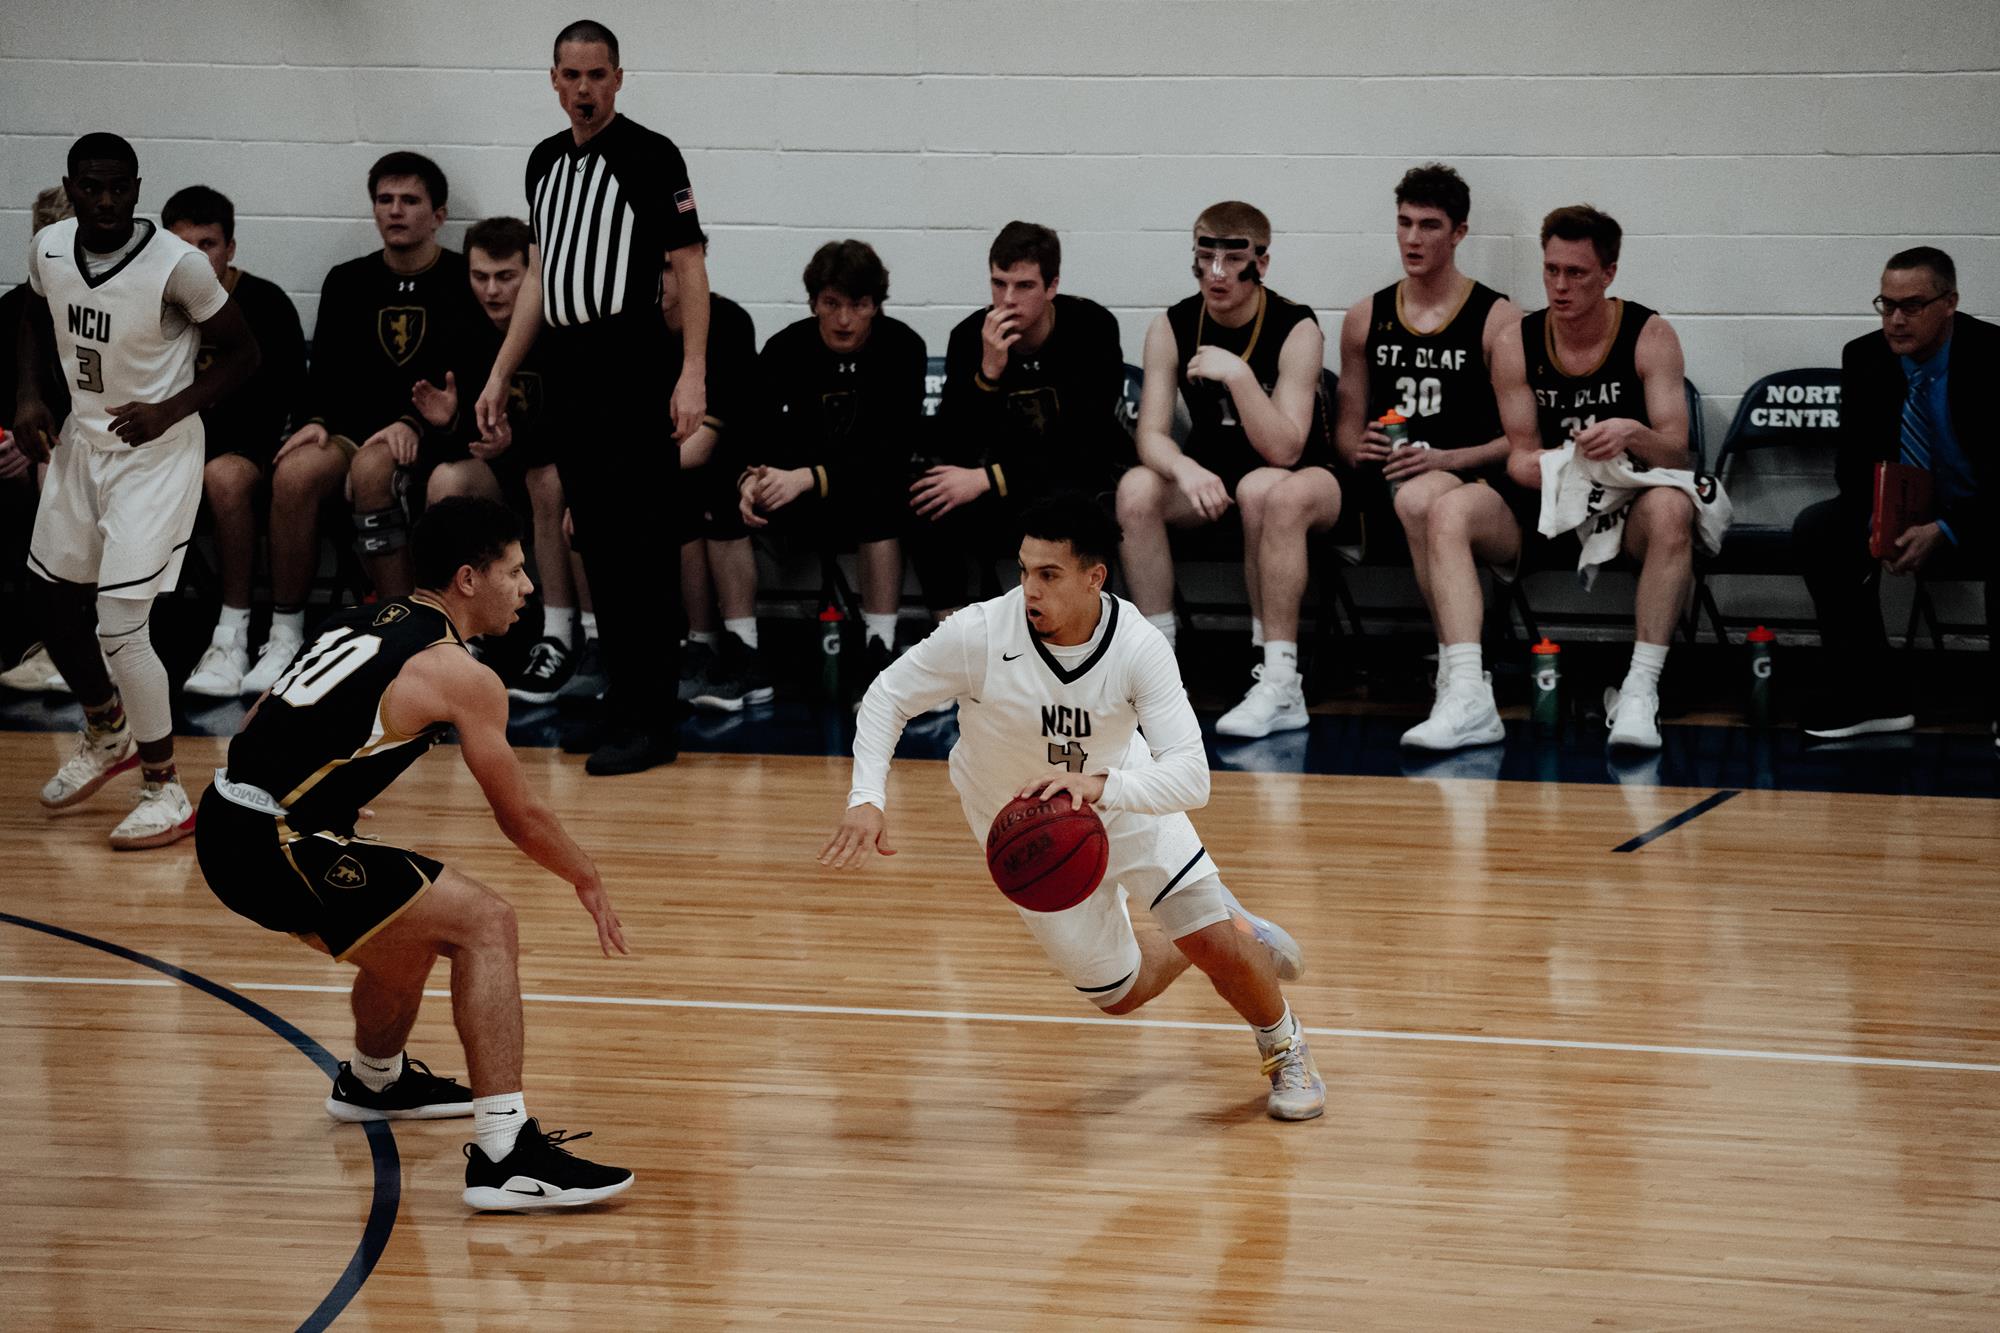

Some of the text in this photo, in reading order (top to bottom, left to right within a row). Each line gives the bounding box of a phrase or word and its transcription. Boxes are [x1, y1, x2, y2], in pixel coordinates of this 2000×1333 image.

[67, 303, 111, 343] NCU
[76, 344, 104, 394] 3
[1377, 344, 1467, 371] ST. OLAF
[1395, 376, 1442, 418] 30
[1766, 385, 1842, 404] NORT
[1750, 407, 1840, 428] CENTR
[823, 633, 840, 655] G
[271, 625, 383, 708] 10
[1536, 668, 1556, 691] G
[1753, 656, 1771, 679] G
[1041, 704, 1092, 738] NCU
[1048, 741, 1089, 773] 4
